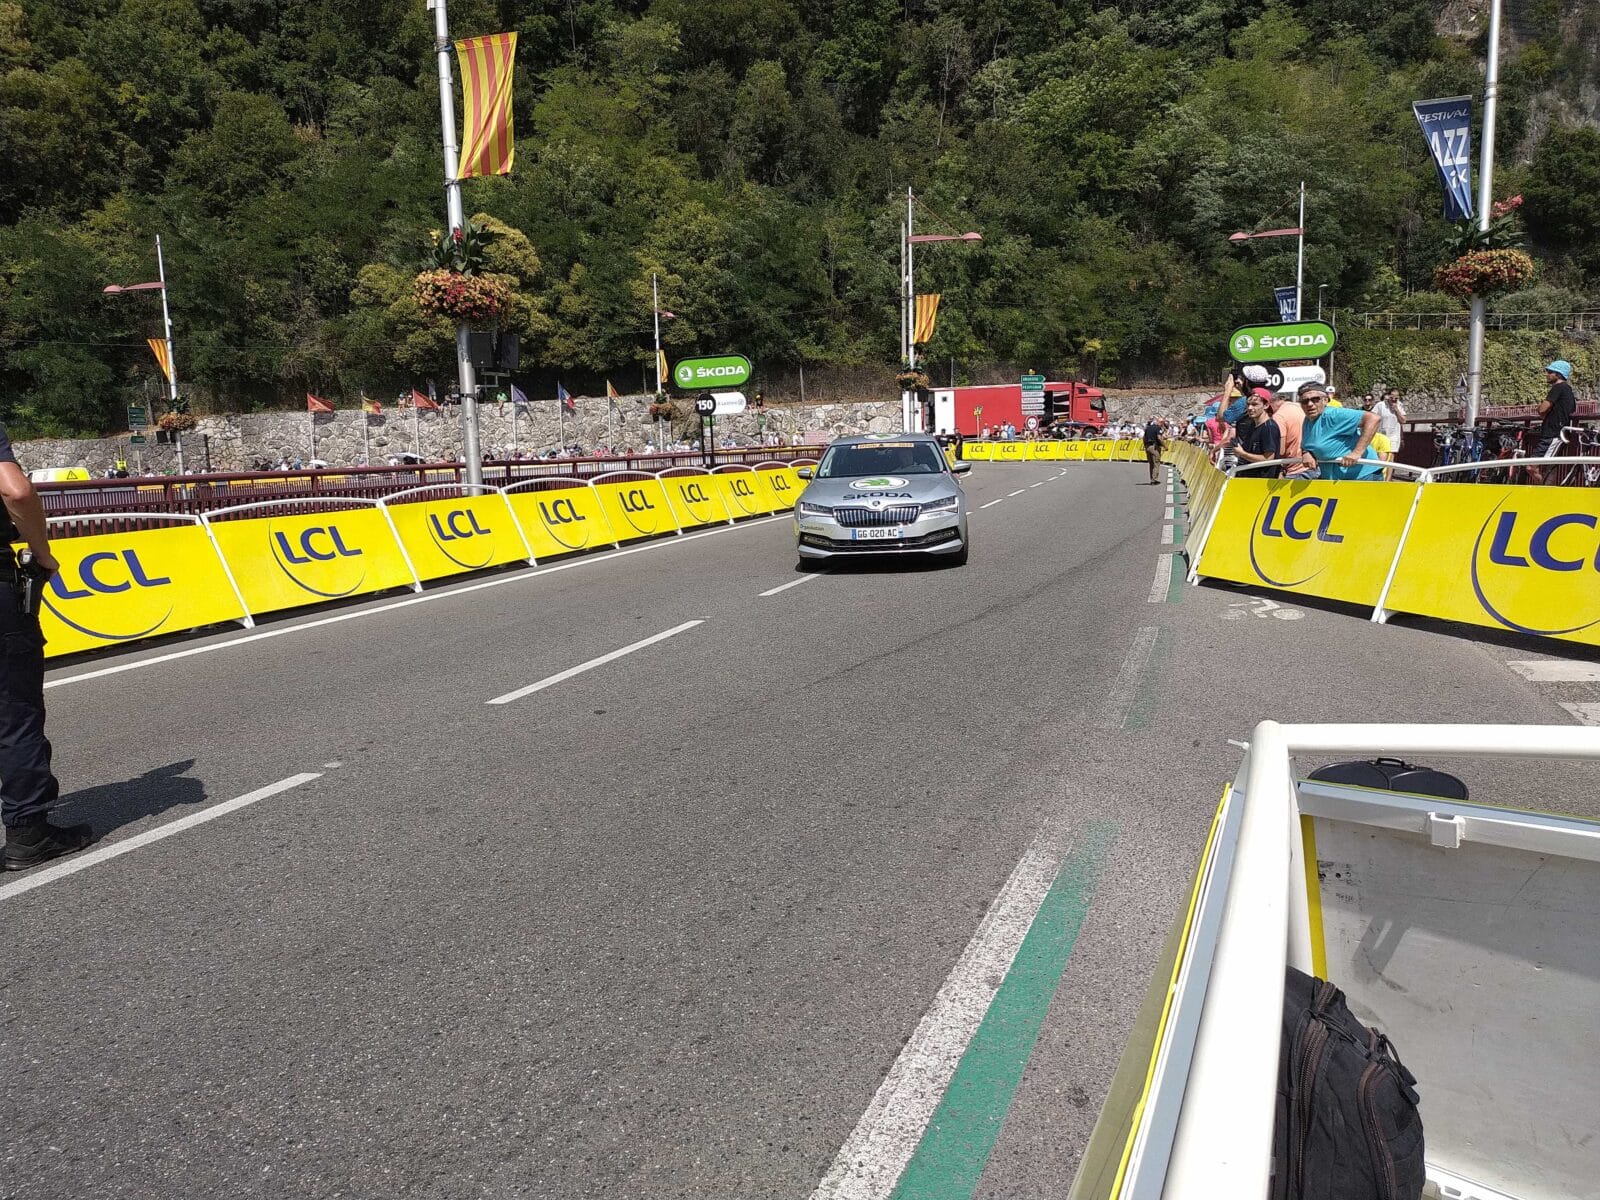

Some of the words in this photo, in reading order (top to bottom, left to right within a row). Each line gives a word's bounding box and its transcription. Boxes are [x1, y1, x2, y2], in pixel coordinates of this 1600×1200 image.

[1420, 108, 1469, 122] FESTIVAL
[1280, 298, 1296, 314] JAZZ
[1259, 334, 1328, 348] ŠKODA
[696, 365, 745, 378] ŠKODA
[1265, 374, 1281, 387] 50
[697, 399, 714, 411] 150
[971, 445, 985, 453] LCL
[1002, 445, 1017, 453] LCL
[1035, 444, 1050, 452] LCL
[1066, 443, 1079, 451] LCL
[1093, 443, 1106, 451] LCL
[729, 478, 754, 497] LCL
[770, 474, 791, 490] LCL
[679, 483, 709, 503] LCL
[619, 489, 654, 513] LCL
[539, 498, 585, 526] LCL
[1261, 495, 1344, 543] LCL
[430, 509, 491, 541] LCL
[857, 529, 867, 538] GG
[869, 529, 885, 538] 020
[887, 528, 898, 537] AC
[275, 525, 363, 564] LCL
[1489, 511, 1600, 571] LC
[48, 549, 171, 600] LCL
